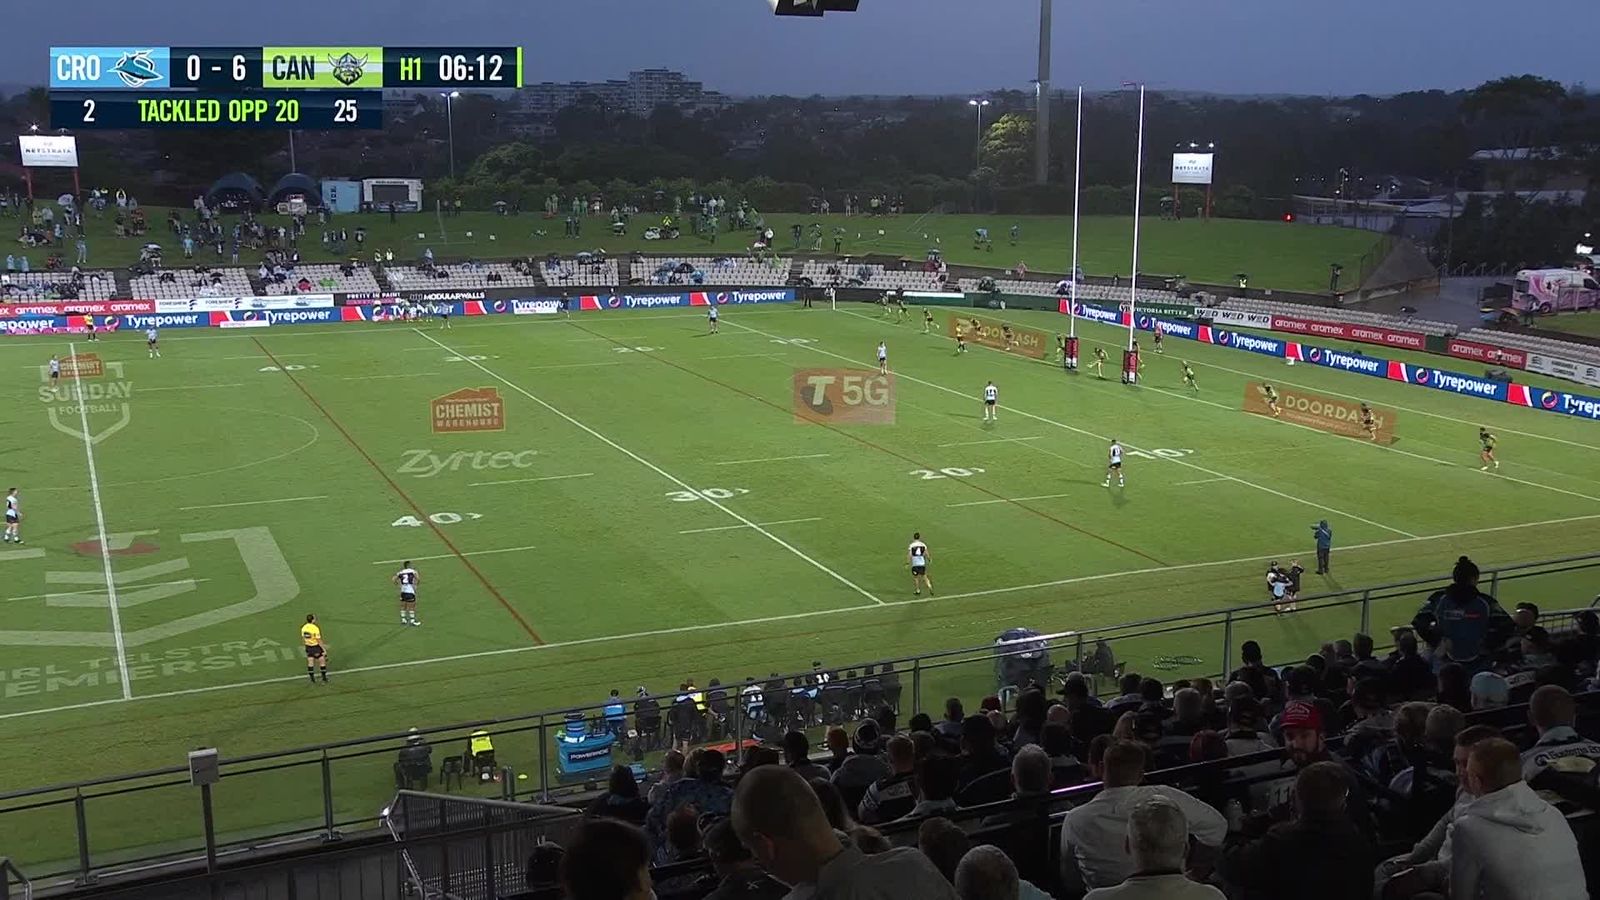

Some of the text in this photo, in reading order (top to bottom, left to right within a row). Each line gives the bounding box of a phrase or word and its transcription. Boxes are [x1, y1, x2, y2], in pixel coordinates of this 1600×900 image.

[624, 295, 681, 308] Tyrepower
[732, 291, 786, 304] Tyrepower
[110, 303, 151, 312] aramex
[1081, 305, 1118, 320] Tyrepower
[0, 319, 54, 330] epower
[125, 314, 198, 329] Tyrepower
[263, 310, 331, 325] Tyrepower
[1275, 318, 1307, 330] aramex
[1311, 323, 1344, 335] aramex
[1352, 328, 1383, 340] aramex
[1231, 332, 1278, 352] Tyrepower
[1387, 333, 1420, 346] aramex
[1451, 343, 1483, 356] aramex
[1324, 349, 1379, 372] Tyrepower
[1432, 370, 1497, 395] Tyrepower
[38, 381, 133, 403] SUNDAY
[842, 375, 889, 407] 5G
[59, 403, 119, 415] FOOTBALL
[435, 402, 500, 418] CHEMIST
[1125, 447, 1184, 460] 10
[396, 448, 542, 478] Zyrtec
[909, 467, 974, 481] 20
[665, 487, 734, 502] 30
[391, 511, 463, 527] 40
[915, 547, 922, 556] 4
[402, 574, 409, 584] 2
[80, 637, 281, 671] TELSTRA
